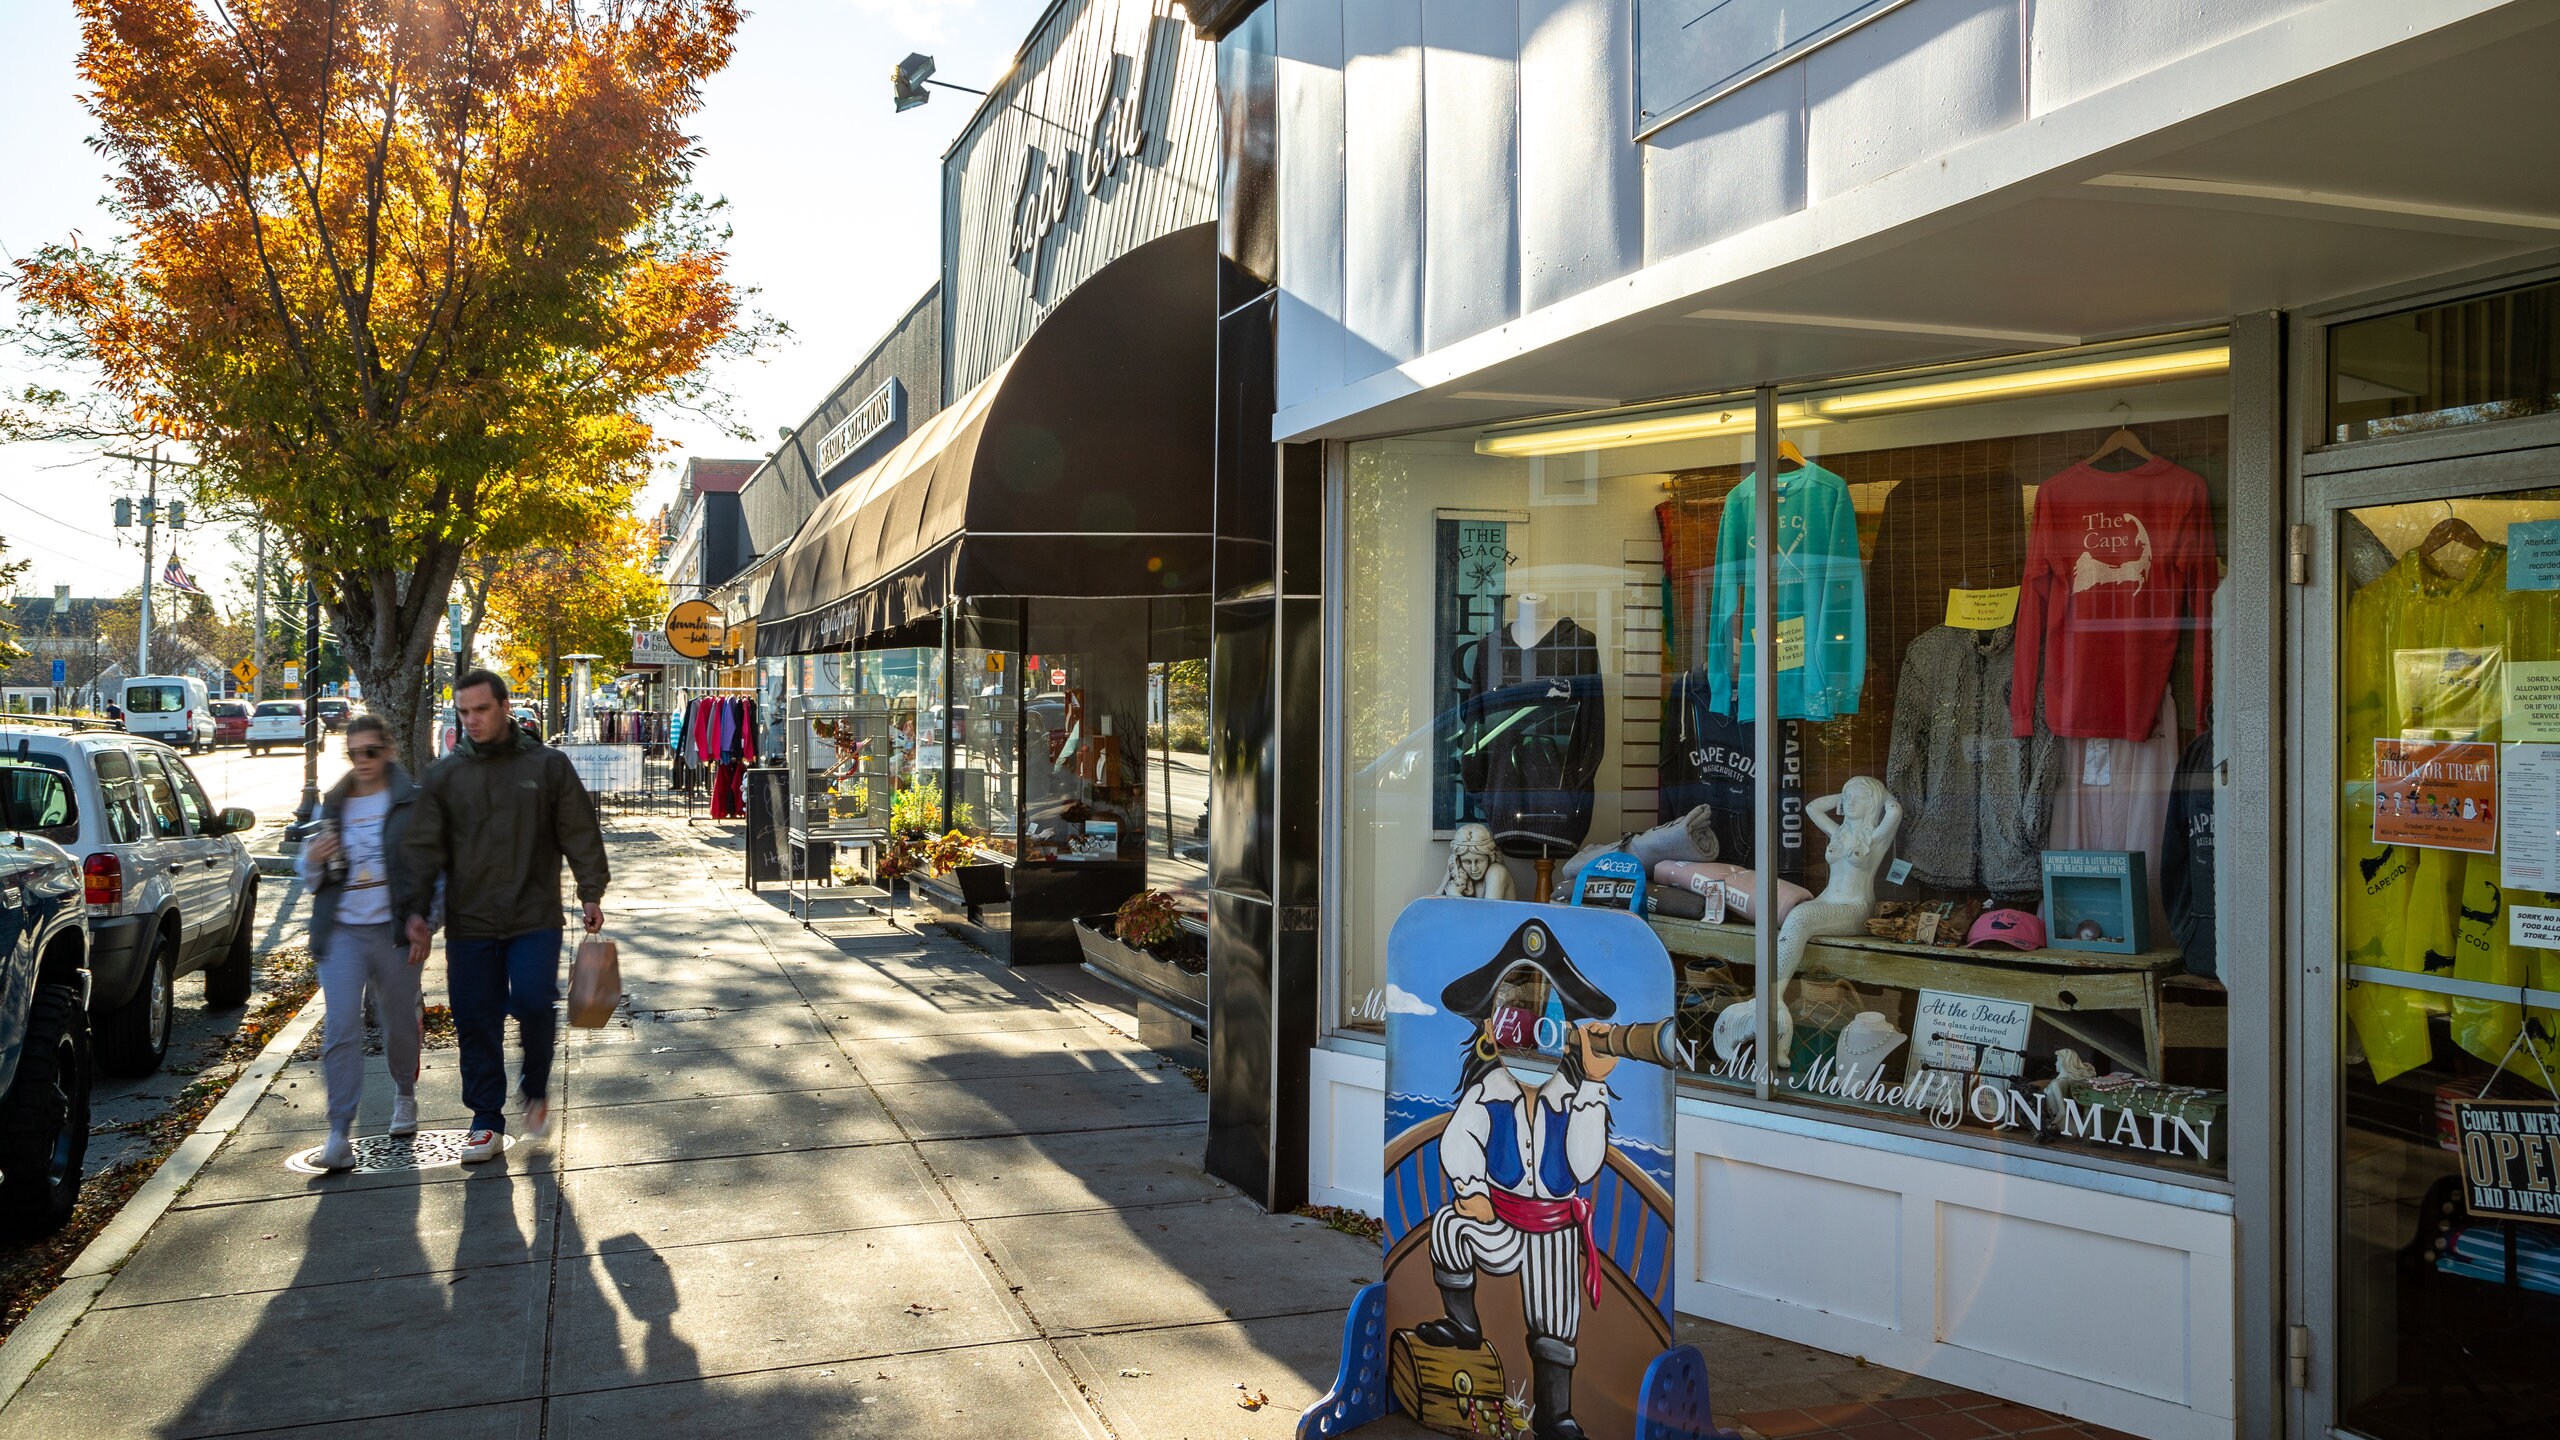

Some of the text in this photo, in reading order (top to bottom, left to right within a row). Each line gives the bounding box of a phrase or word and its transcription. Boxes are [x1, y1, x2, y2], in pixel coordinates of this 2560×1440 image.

[2083, 512, 2123, 531] The
[1464, 528, 1502, 543] THE
[2083, 532, 2129, 552] Cape
[1447, 544, 1519, 567] BEACH
[651, 643, 672, 651] blue
[1689, 746, 1725, 766] CAPE
[1782, 720, 1801, 789] CAPE
[2381, 760, 2490, 782] TRICK OR TREAT
[1782, 796, 1803, 848] COD
[2045, 864, 2127, 874] OF THE BEACH HOME WITH ME
[2048, 855, 2069, 864] ALWAYS
[2070, 856, 2084, 864] TAKE
[2091, 857, 2108, 865] LITTLE
[2109, 857, 2127, 865] PIECE
[1584, 883, 1611, 894] APE
[2367, 864, 2407, 895] CAPE COD
[2517, 912, 2542, 921] SORRY,
[2465, 934, 2490, 952] COD
[1923, 999, 2024, 1025] At the Beach
[1932, 1018, 2007, 1036] Sea glass, driftwood
[1951, 1032, 1977, 1042] perfect
[1979, 1035, 2000, 1045] shells
[1936, 1051, 1969, 1062] mmaid
[1710, 1042, 1780, 1087] Mrs.
[1788, 1054, 1953, 1115] Mitchell's
[1970, 1084, 2046, 1131] ON
[2060, 1098, 2212, 1160] MAIN
[2461, 1110, 2560, 1135] COME IN WE'R
[2474, 1187, 2504, 1209] AND
